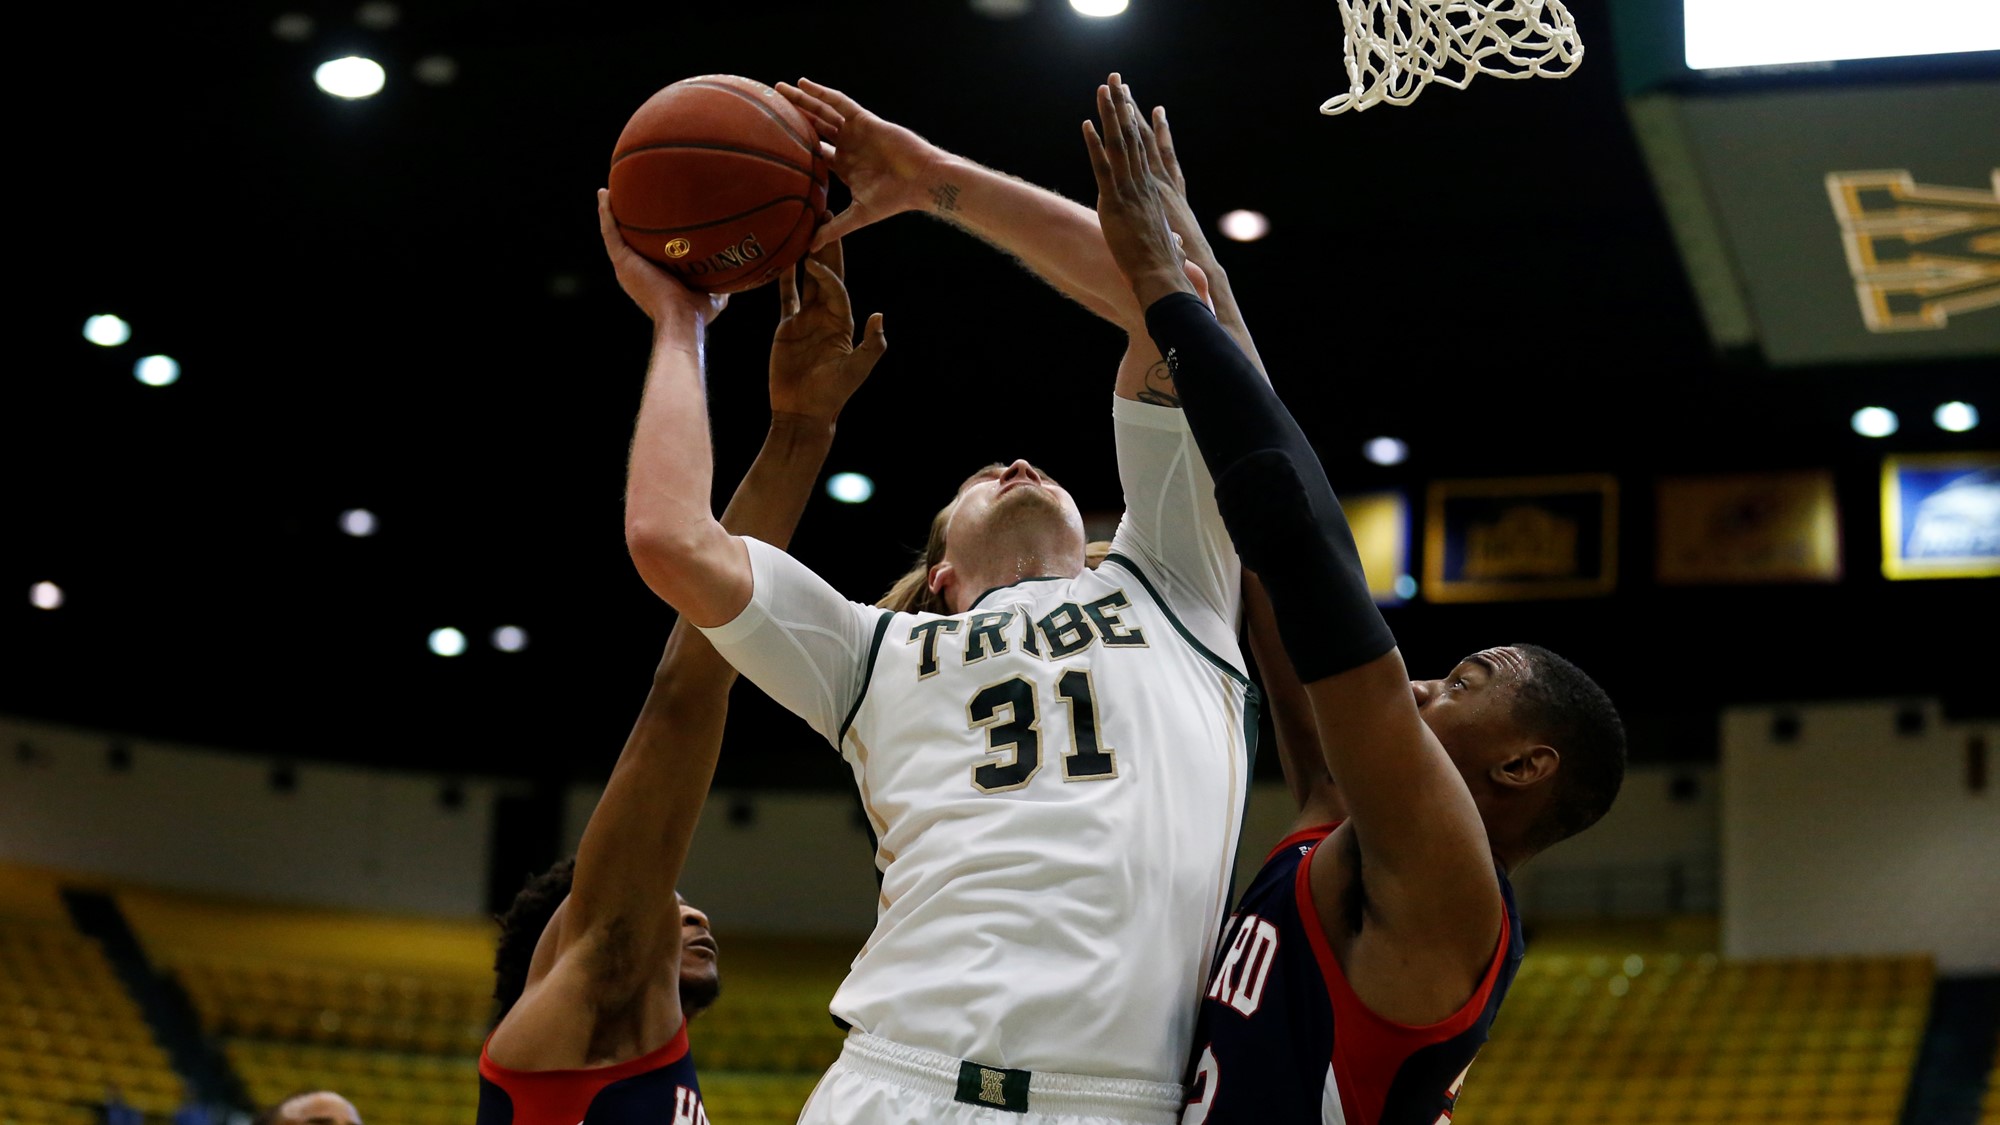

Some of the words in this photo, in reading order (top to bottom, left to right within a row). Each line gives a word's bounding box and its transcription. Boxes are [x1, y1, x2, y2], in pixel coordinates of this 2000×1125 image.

[906, 587, 1150, 682] TRIBE
[965, 666, 1119, 794] 31
[1206, 912, 1280, 1020] RD
